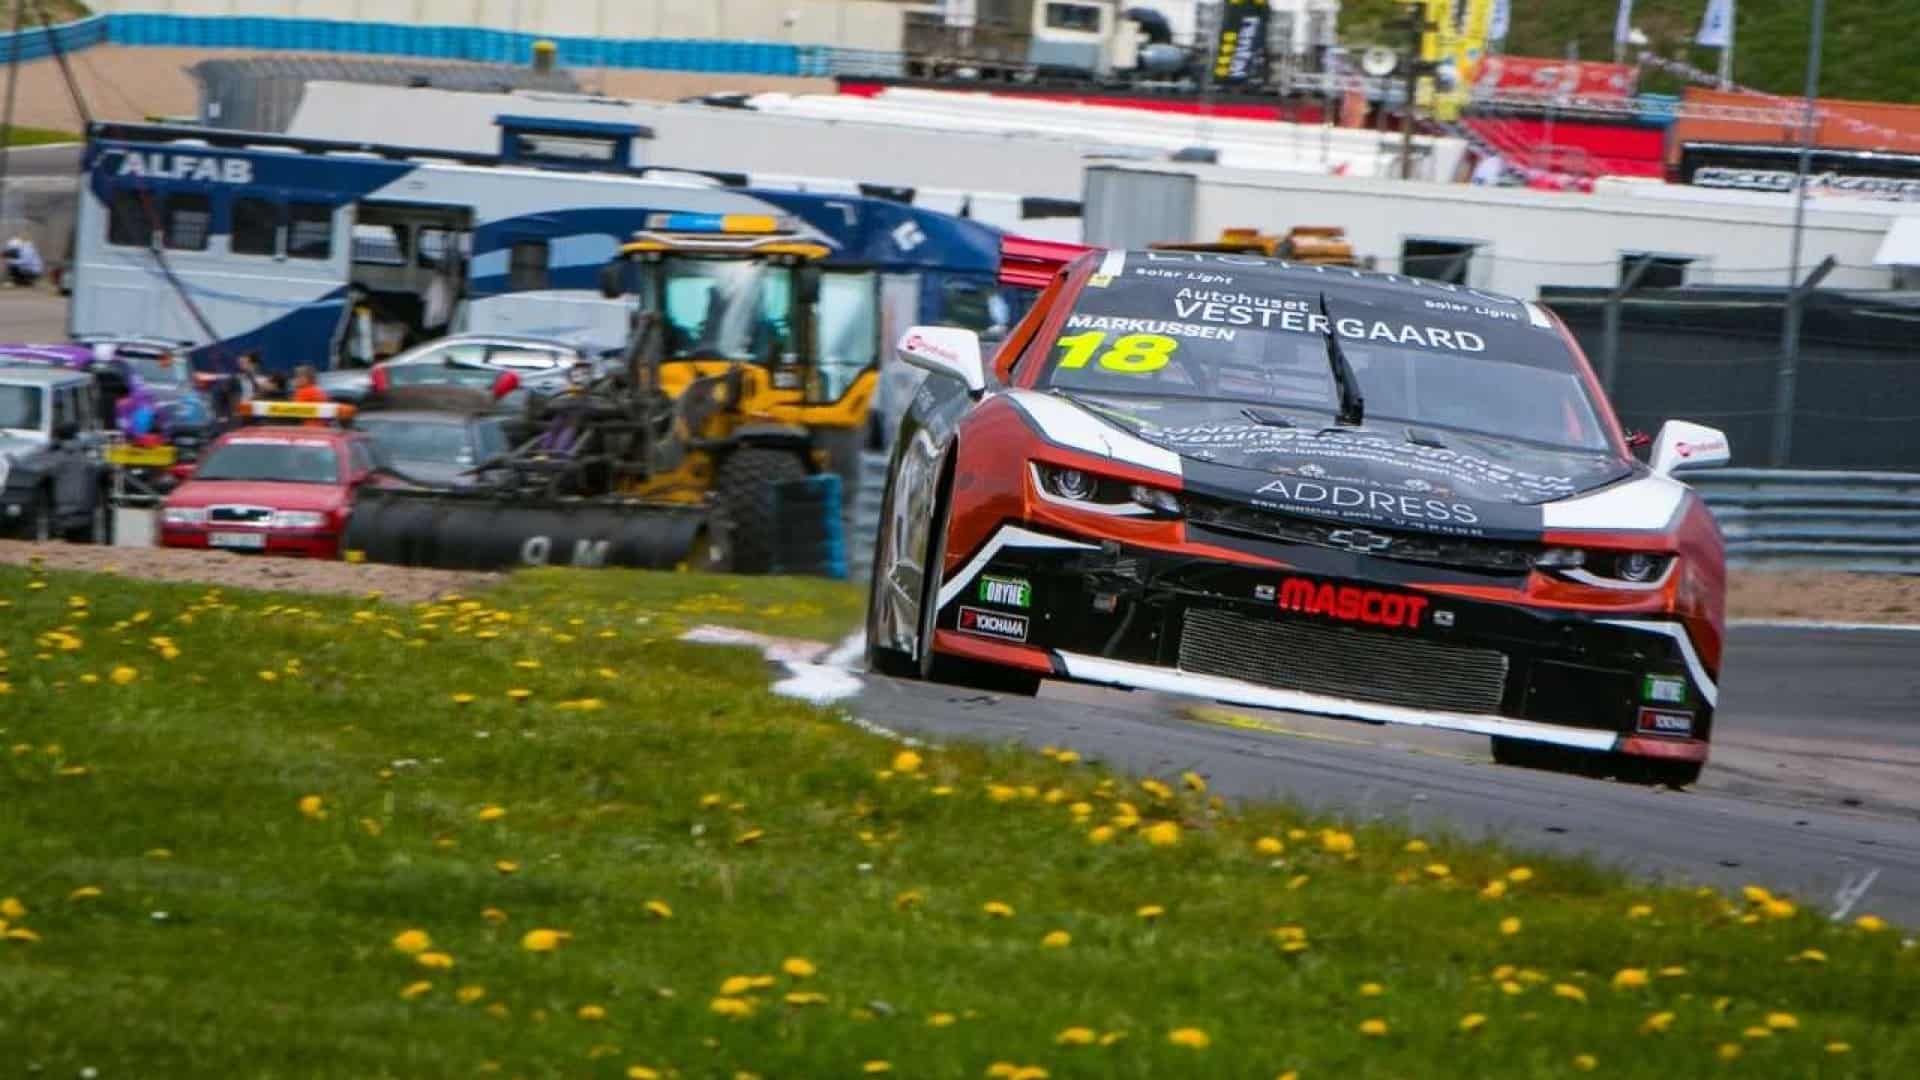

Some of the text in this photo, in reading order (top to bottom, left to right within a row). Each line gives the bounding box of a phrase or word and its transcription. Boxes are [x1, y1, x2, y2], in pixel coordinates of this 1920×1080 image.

[117, 152, 253, 184] ALFAB
[1136, 267, 1234, 286] Solar Light
[1176, 286, 1309, 313] Autohuset
[1067, 315, 1237, 342] MARKUSSEN
[1174, 298, 1486, 351] VESTERGAARD
[1057, 330, 1179, 373] 18
[1256, 478, 1479, 524] ADDRESS
[1279, 577, 1429, 628] MASCOT
